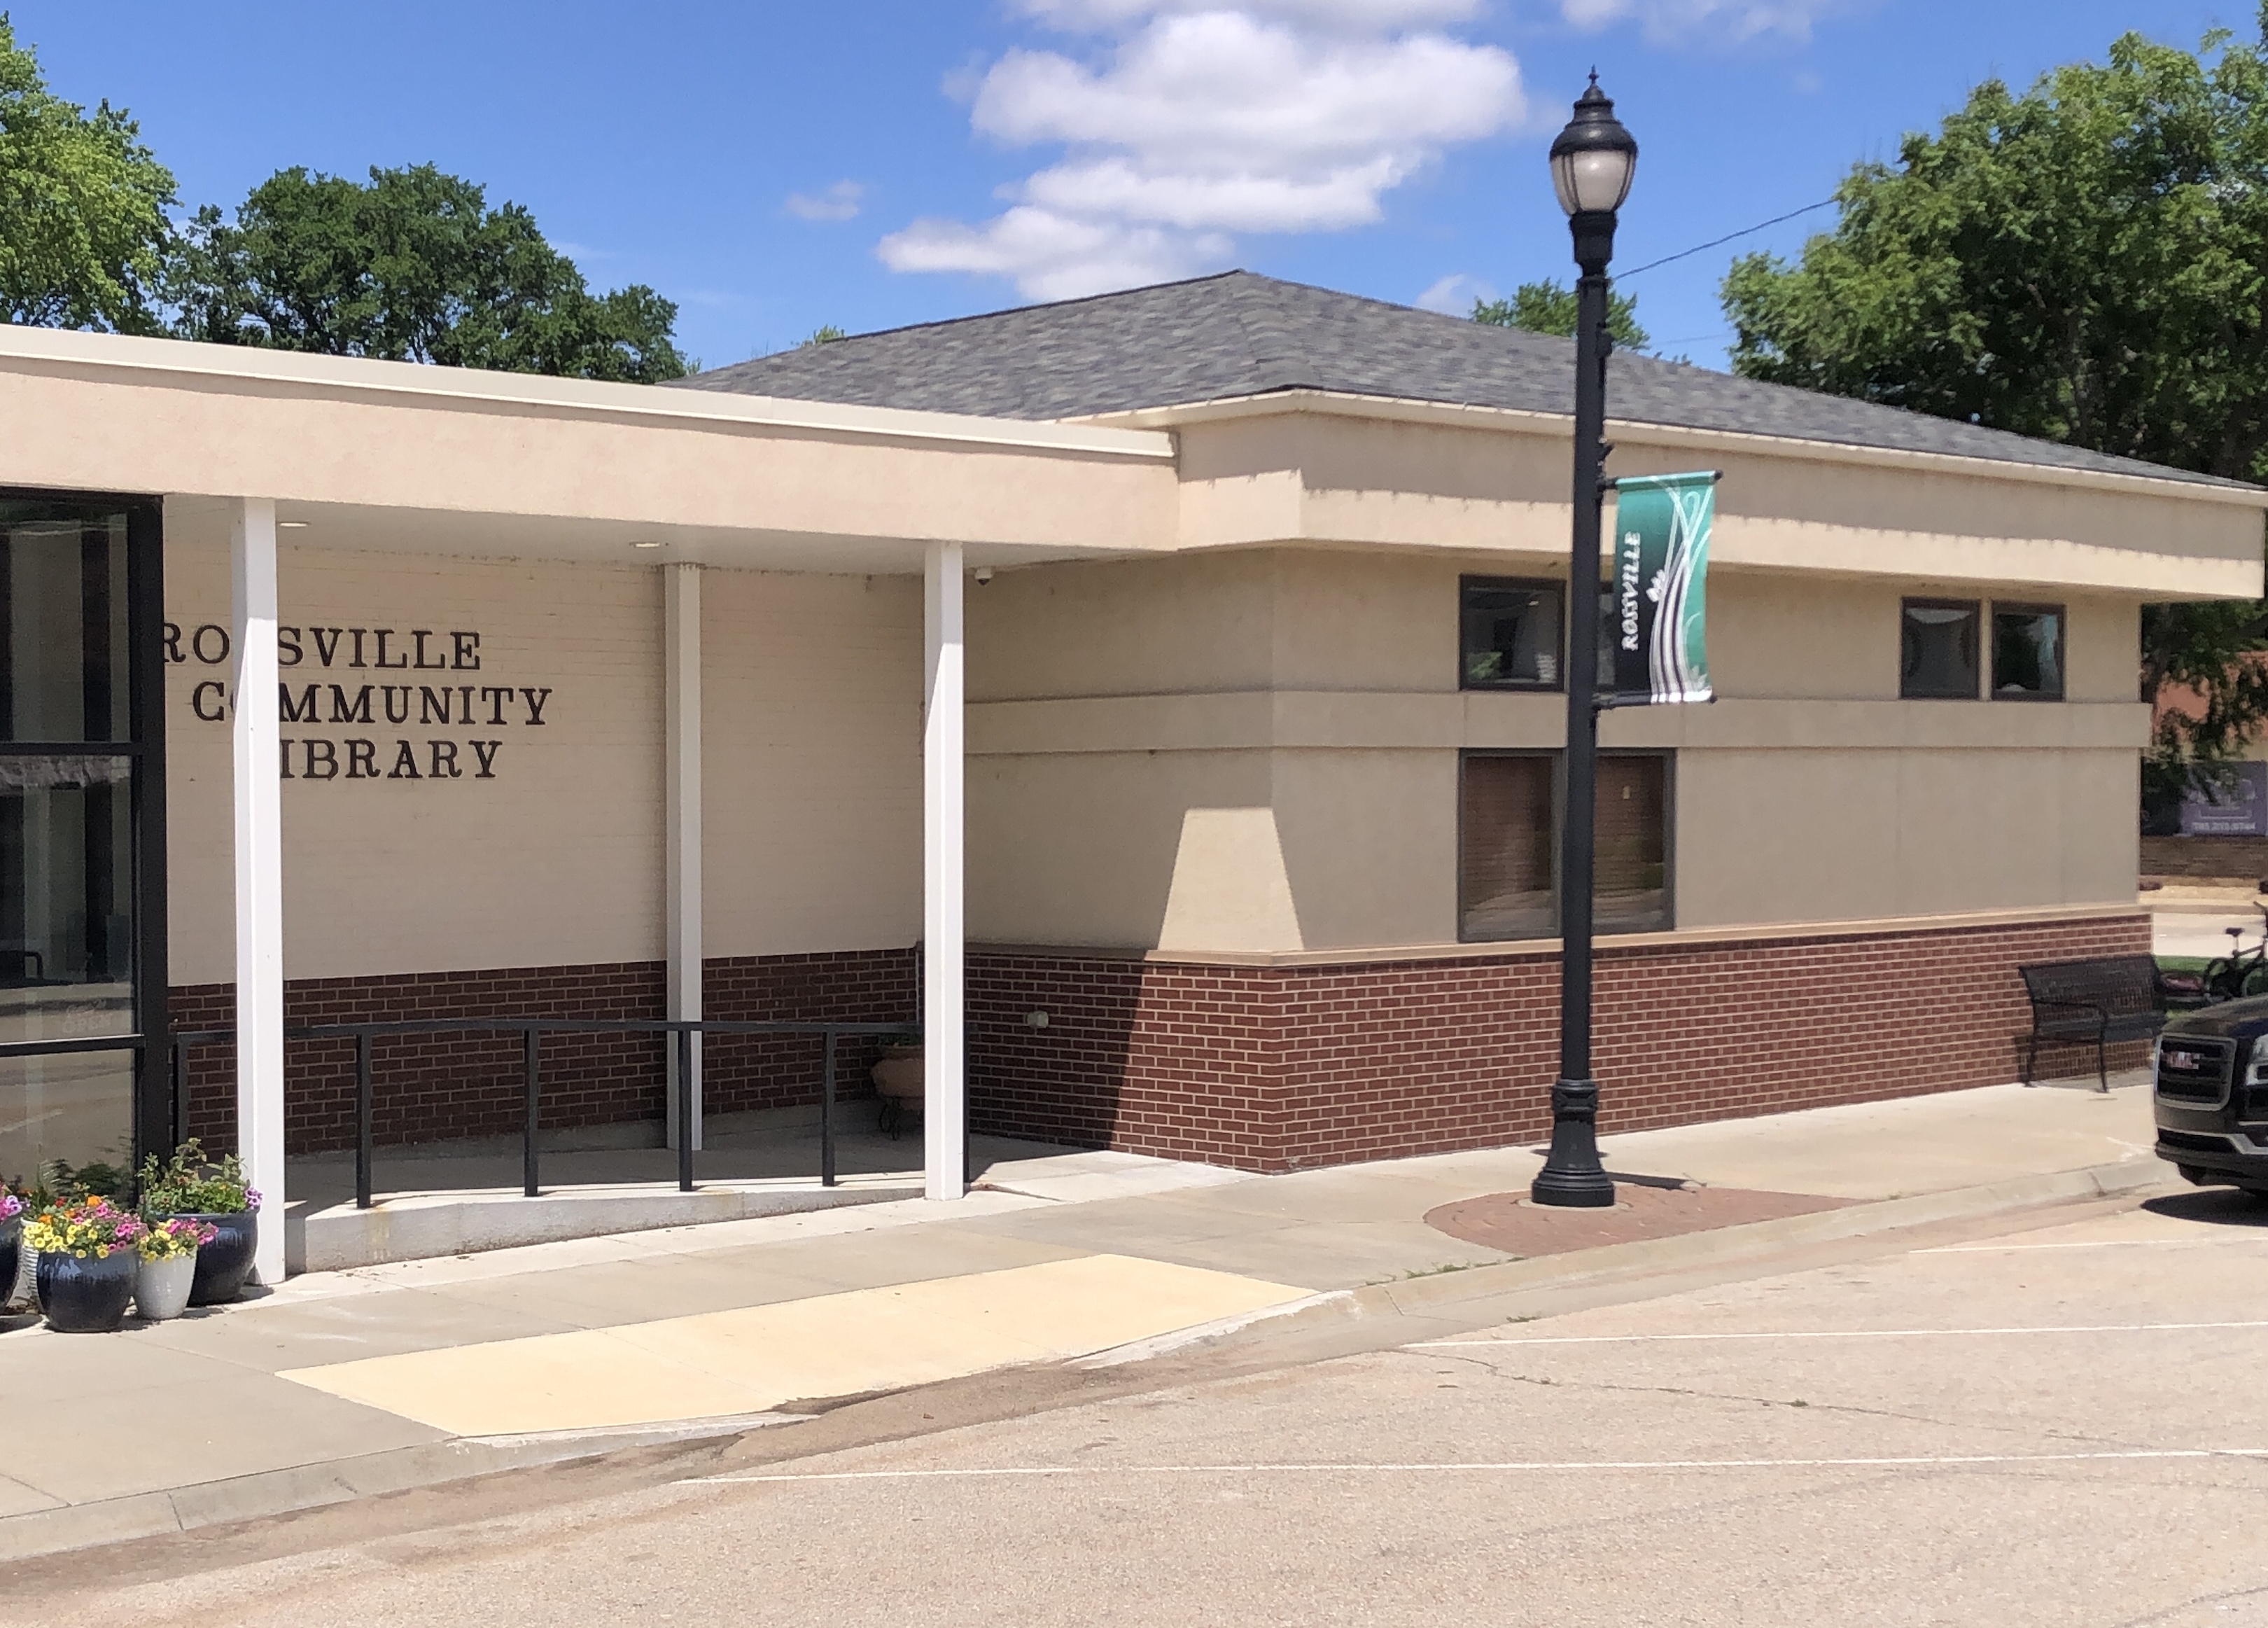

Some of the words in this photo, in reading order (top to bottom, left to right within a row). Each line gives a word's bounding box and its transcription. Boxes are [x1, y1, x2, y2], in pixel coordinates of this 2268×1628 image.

[1621, 531, 1640, 651] ROSSVILLE
[164, 622, 481, 670] ROSVILLE
[192, 681, 552, 725] CMMUNITY
[279, 739, 503, 781] IBRARY
